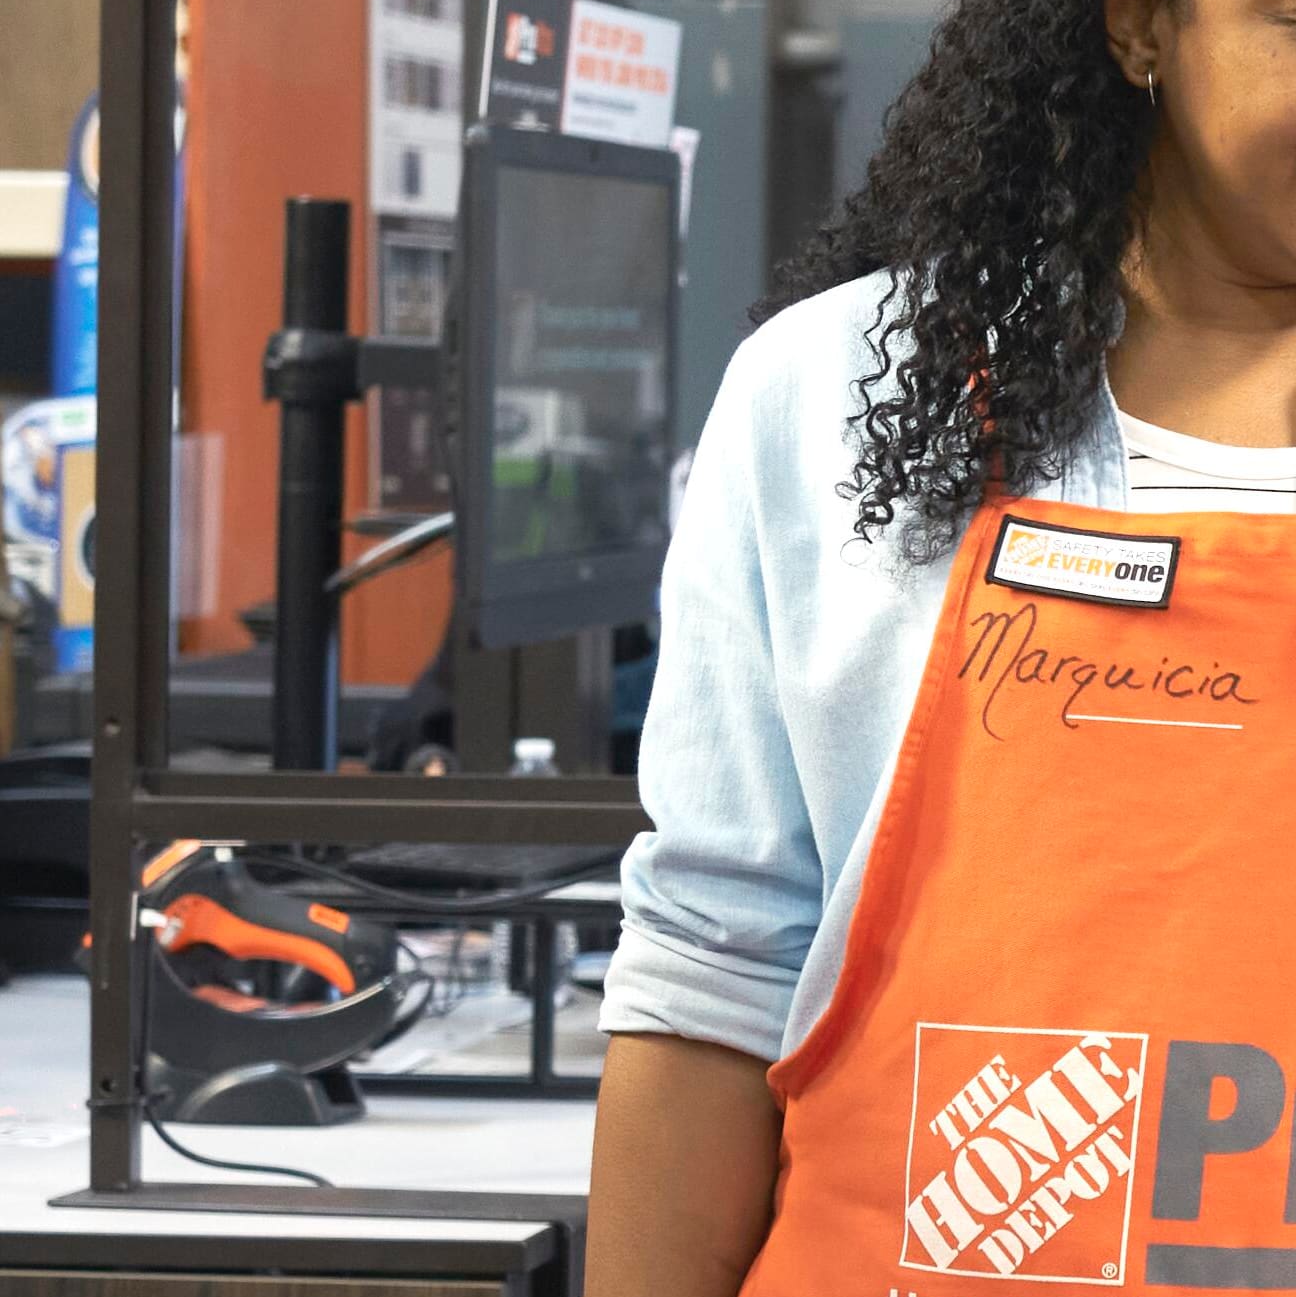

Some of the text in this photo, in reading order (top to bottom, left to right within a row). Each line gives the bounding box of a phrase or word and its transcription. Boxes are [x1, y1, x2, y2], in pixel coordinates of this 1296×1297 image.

[1053, 539, 1114, 556] SAFETY
[1120, 547, 1166, 563] TAKES
[905, 1035, 1141, 1270] HOME
[929, 1055, 1022, 1152] THE
[977, 1125, 1131, 1276] DEPOT
